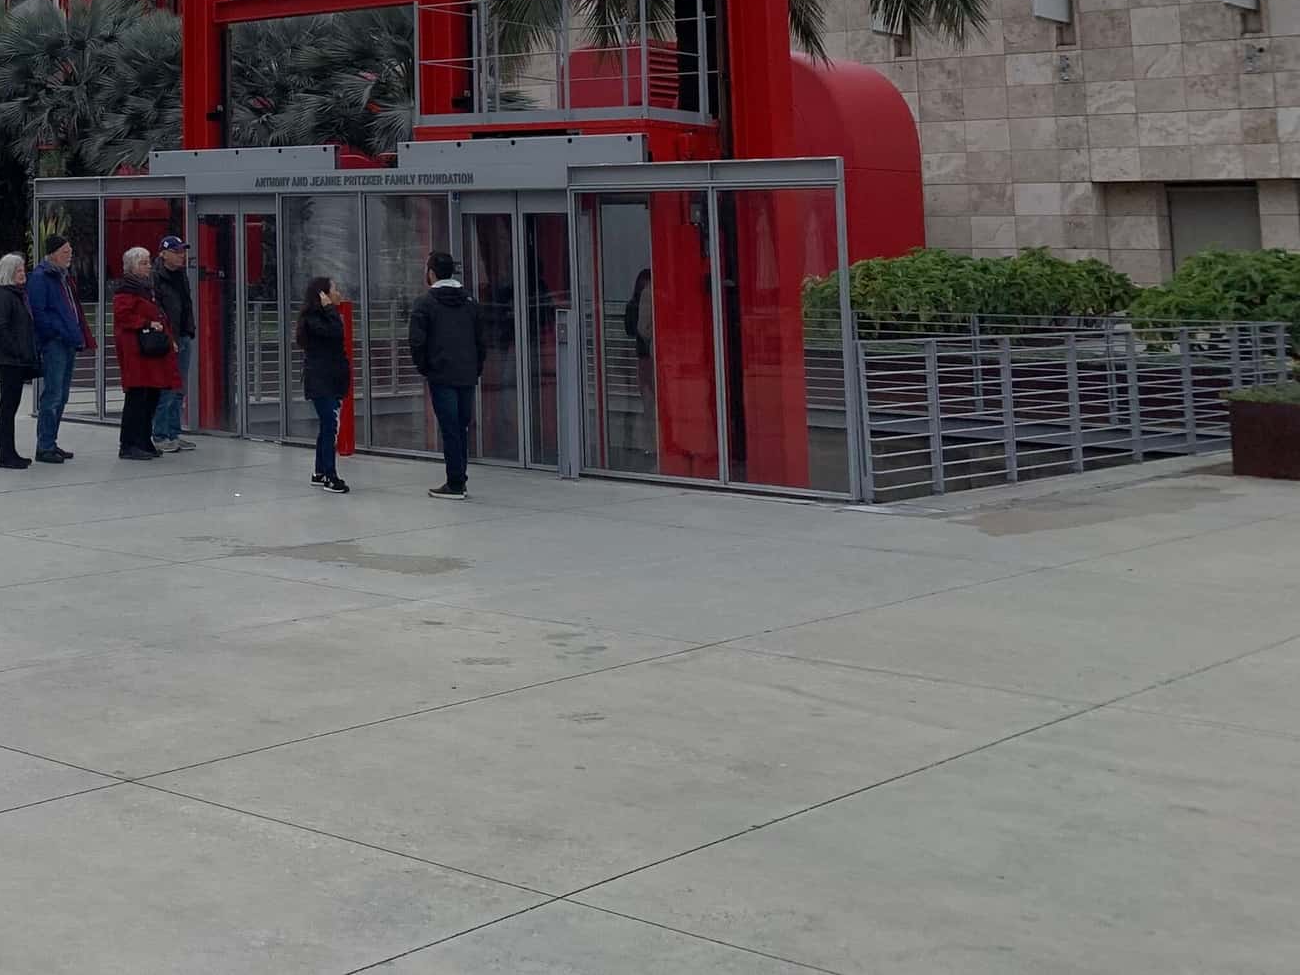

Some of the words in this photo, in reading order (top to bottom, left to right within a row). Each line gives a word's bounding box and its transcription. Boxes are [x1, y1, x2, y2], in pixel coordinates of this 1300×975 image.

[254, 176, 290, 188] ANTHONY
[292, 176, 308, 187] AND
[309, 175, 342, 186] JEANNE
[343, 175, 383, 186] PRITZKER
[385, 174, 416, 185] FAMILY
[418, 172, 474, 185] FOUNDATION
